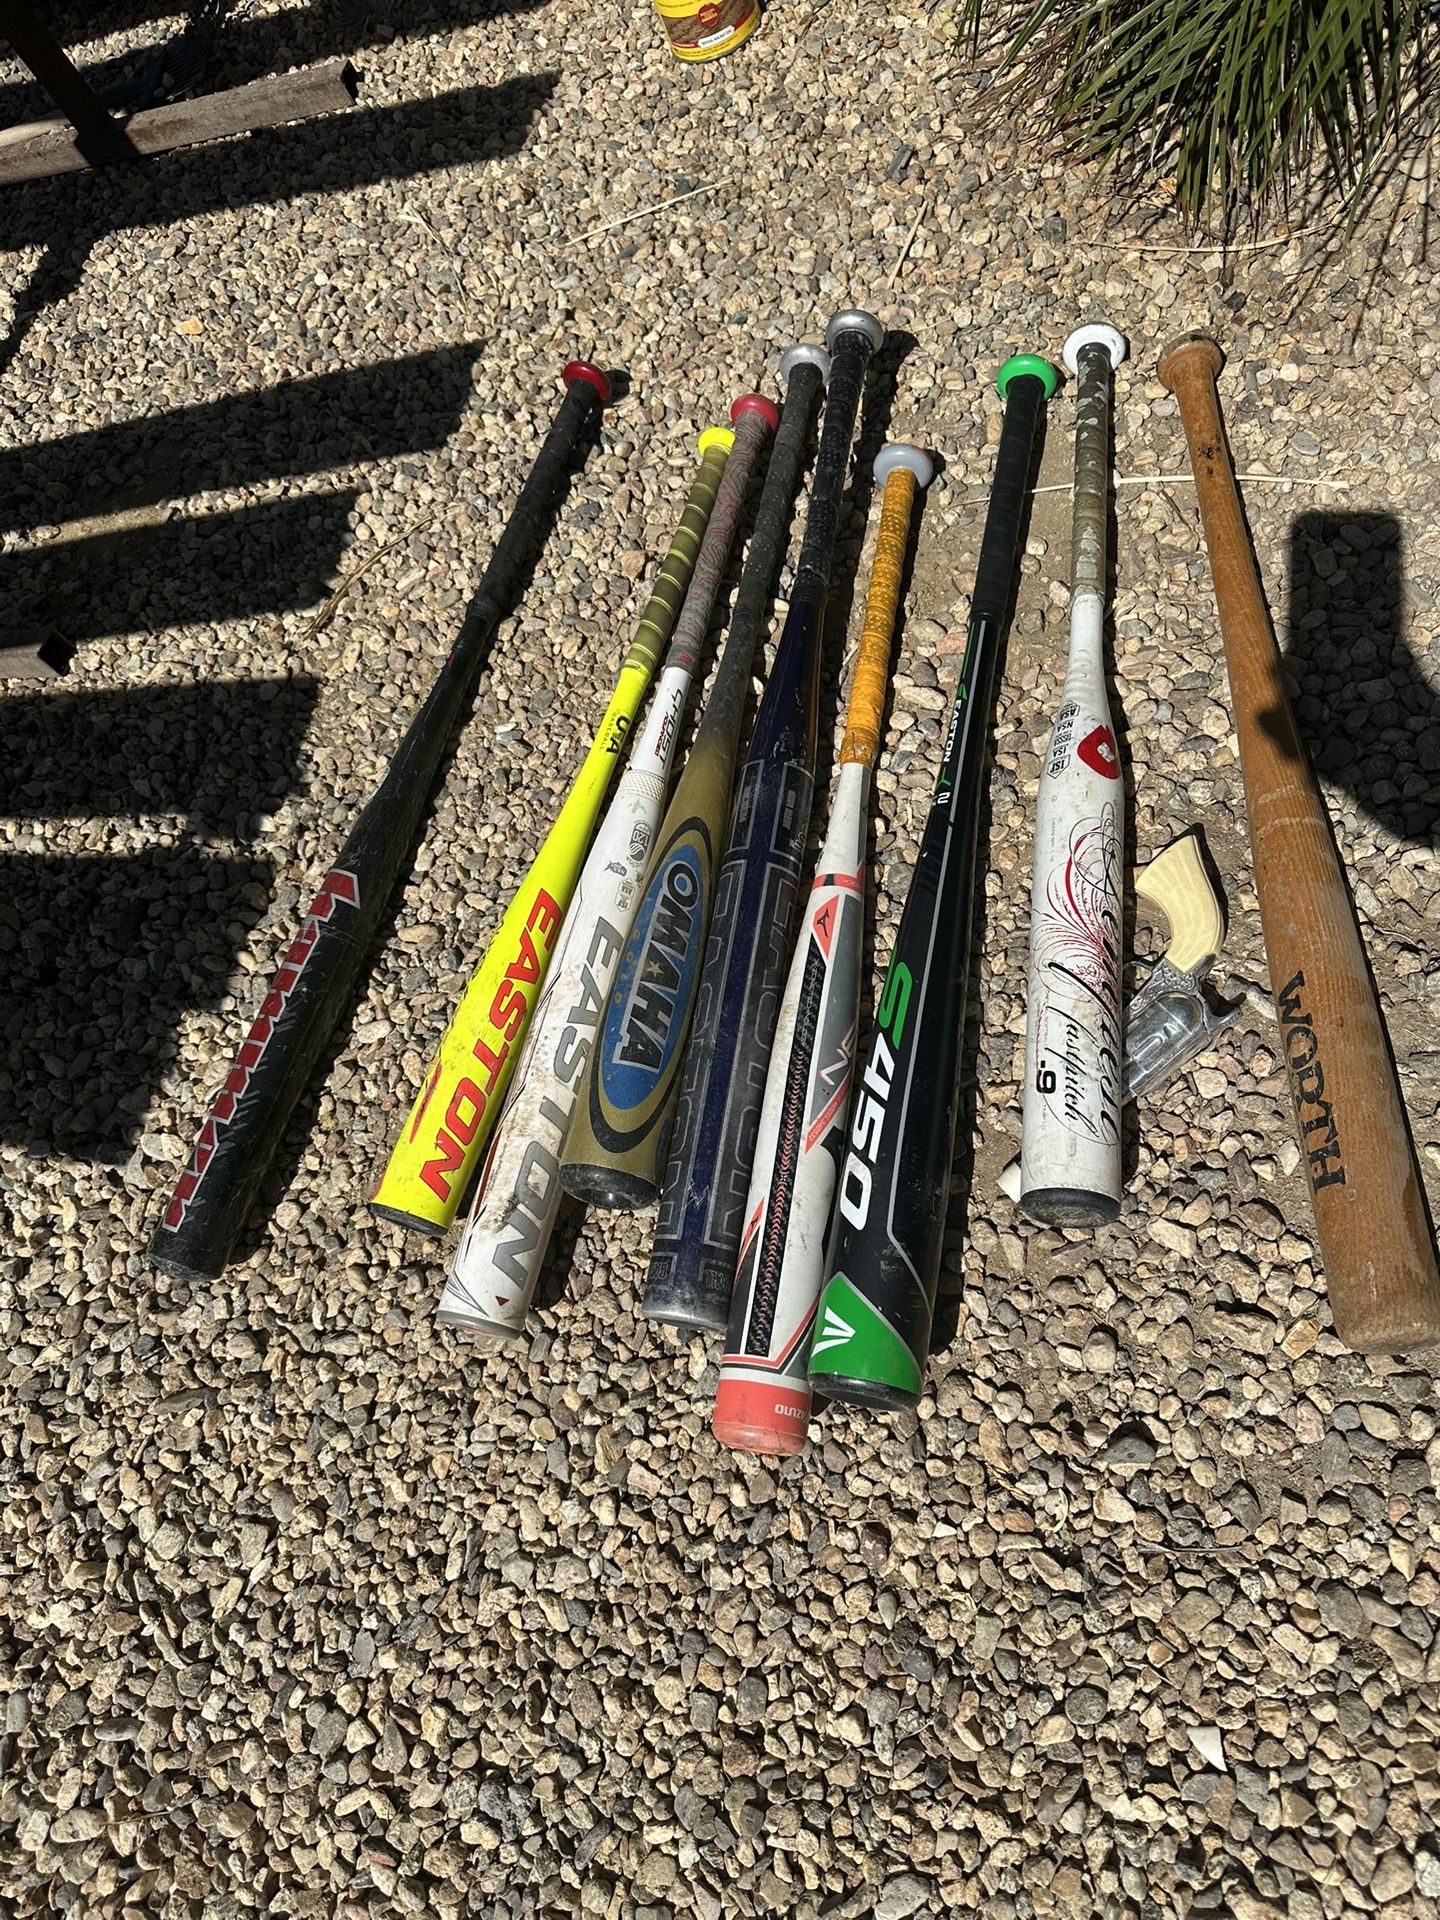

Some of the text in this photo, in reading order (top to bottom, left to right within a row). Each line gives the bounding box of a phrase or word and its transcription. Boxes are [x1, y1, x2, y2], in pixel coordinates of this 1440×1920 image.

[599, 710, 616, 753] BASEBALL
[655, 710, 671, 757] ADVANCED
[658, 688, 685, 770] GHOST
[943, 699, 962, 762] EASTON
[420, 888, 563, 1202] EASTON
[614, 860, 698, 1072] OMAHA
[491, 915, 624, 1291] EASTON
[839, 960, 913, 1232] S450
[1277, 970, 1348, 1193] WORTH
